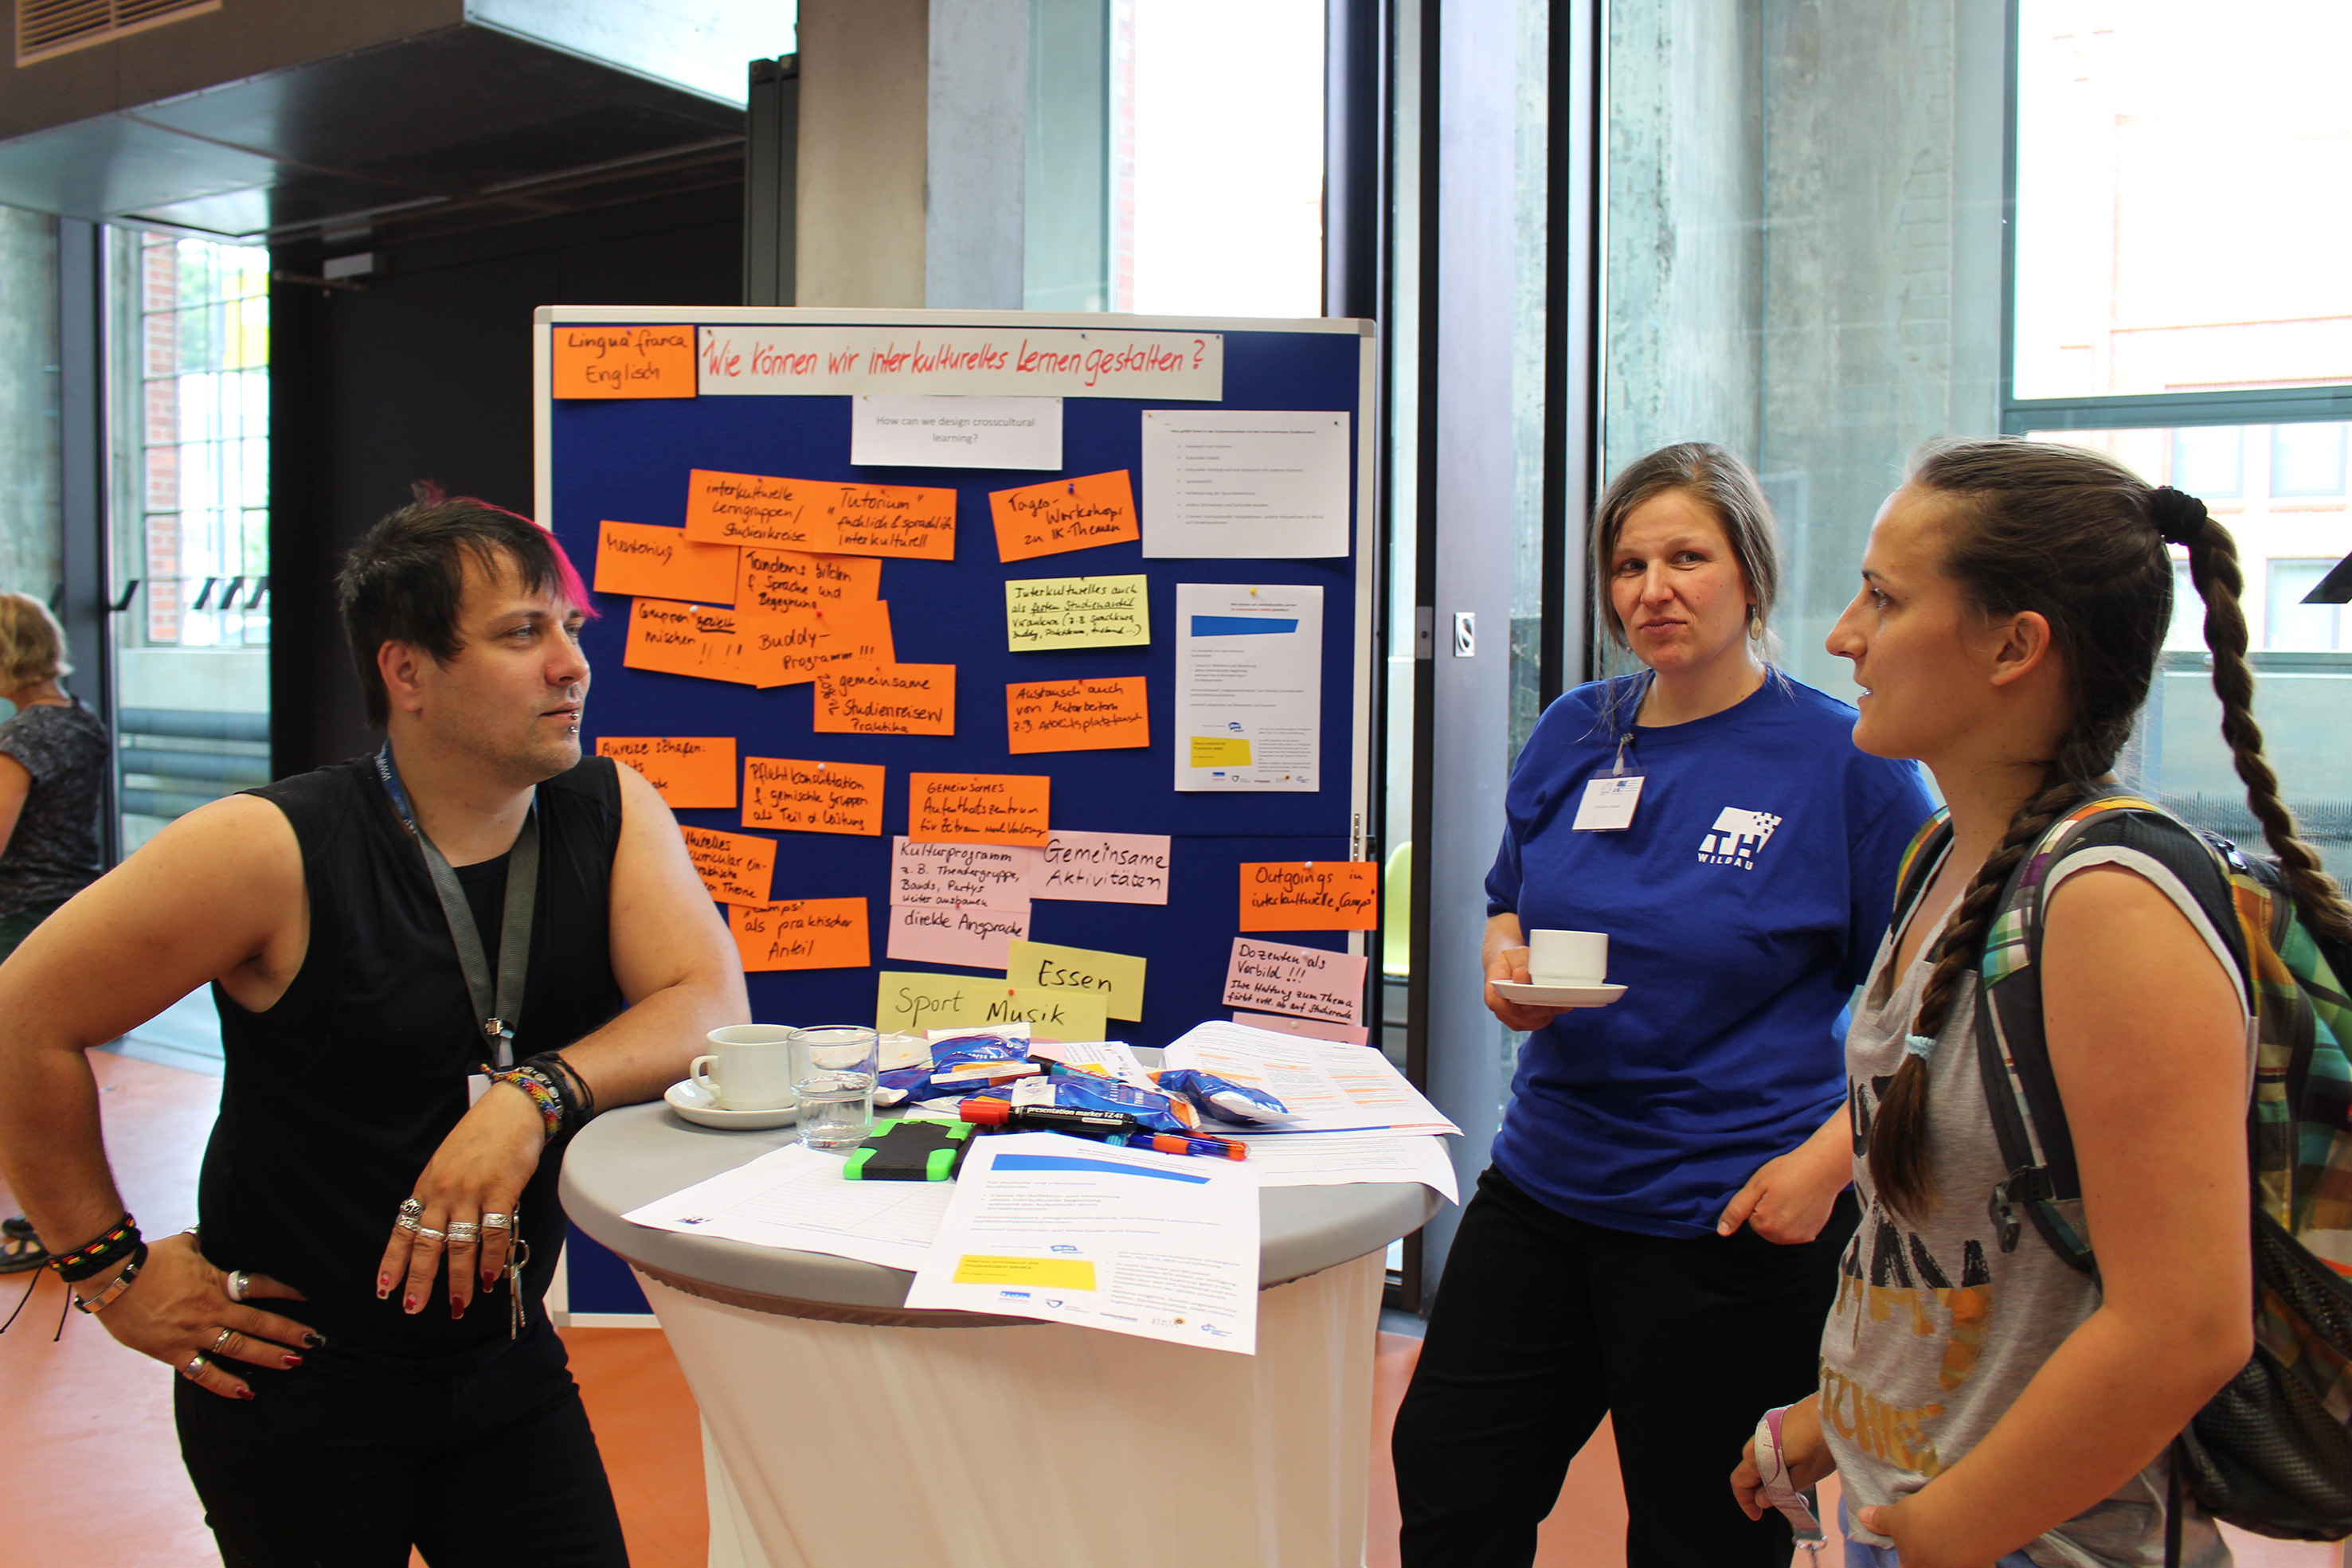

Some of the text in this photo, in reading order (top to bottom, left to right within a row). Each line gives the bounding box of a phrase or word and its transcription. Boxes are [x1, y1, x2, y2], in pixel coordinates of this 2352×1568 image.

[568, 333, 629, 358] Lingua
[702, 338, 742, 377] Wie
[828, 346, 859, 375] wir
[868, 340, 1009, 376] interkulturelles
[1016, 339, 1081, 373] Lernen
[585, 362, 660, 390] Englisch
[876, 416, 898, 426] How
[938, 416, 970, 428] design
[972, 417, 1035, 428] crosscultural
[932, 433, 979, 445] learning?
[706, 479, 794, 502] interkulturelle
[722, 522, 808, 543] Studienkreise
[839, 530, 928, 548] interkulturell
[1024, 534, 1043, 545] zu
[818, 585, 841, 599] und
[1014, 584, 1138, 599] Interkulturelles auch
[1012, 604, 1026, 613] als
[839, 675, 931, 698] gemeinsame
[1016, 682, 1124, 699] Austausch auch
[1016, 705, 1042, 716] von
[850, 718, 909, 733] Praktika
[780, 807, 802, 823] Teil
[900, 842, 1013, 866] Kulturprogramm
[1043, 838, 1170, 870] Gemeinsame
[1696, 852, 1755, 871] WILDAU
[947, 879, 984, 896] Partys
[1045, 869, 1163, 890] Aktivitäten
[1254, 866, 1364, 895] Outgoings in
[745, 917, 766, 933] als
[767, 939, 815, 962] Anteil
[1239, 944, 1326, 970] Dozenten als
[1038, 959, 1113, 993] Essen
[1238, 960, 1282, 980] Vorbild
[894, 987, 1066, 1027] Sport Musik
[1296, 991, 1317, 1002] zum
[1319, 992, 1353, 1008] Thema
[1026, 1106, 1075, 1116] presentation
